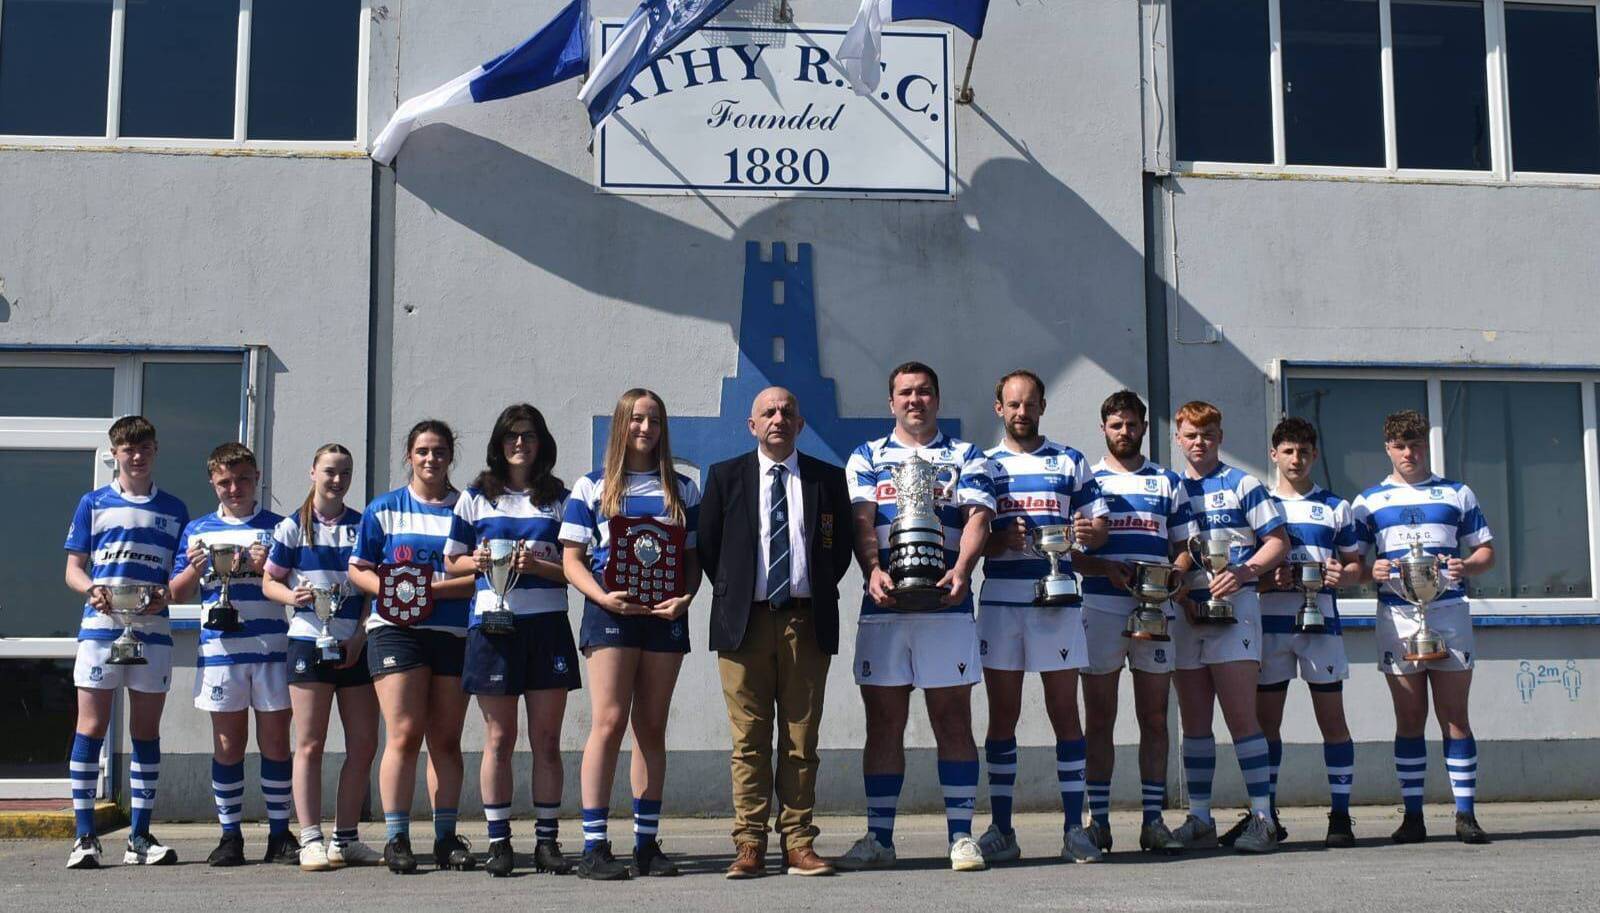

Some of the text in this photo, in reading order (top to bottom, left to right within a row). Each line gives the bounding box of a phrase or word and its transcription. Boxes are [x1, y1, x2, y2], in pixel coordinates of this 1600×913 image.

[794, 44, 939, 122] R..C.
[706, 99, 846, 131] Founded
[723, 147, 830, 185] 1880
[1537, 664, 1559, 677] 2m
